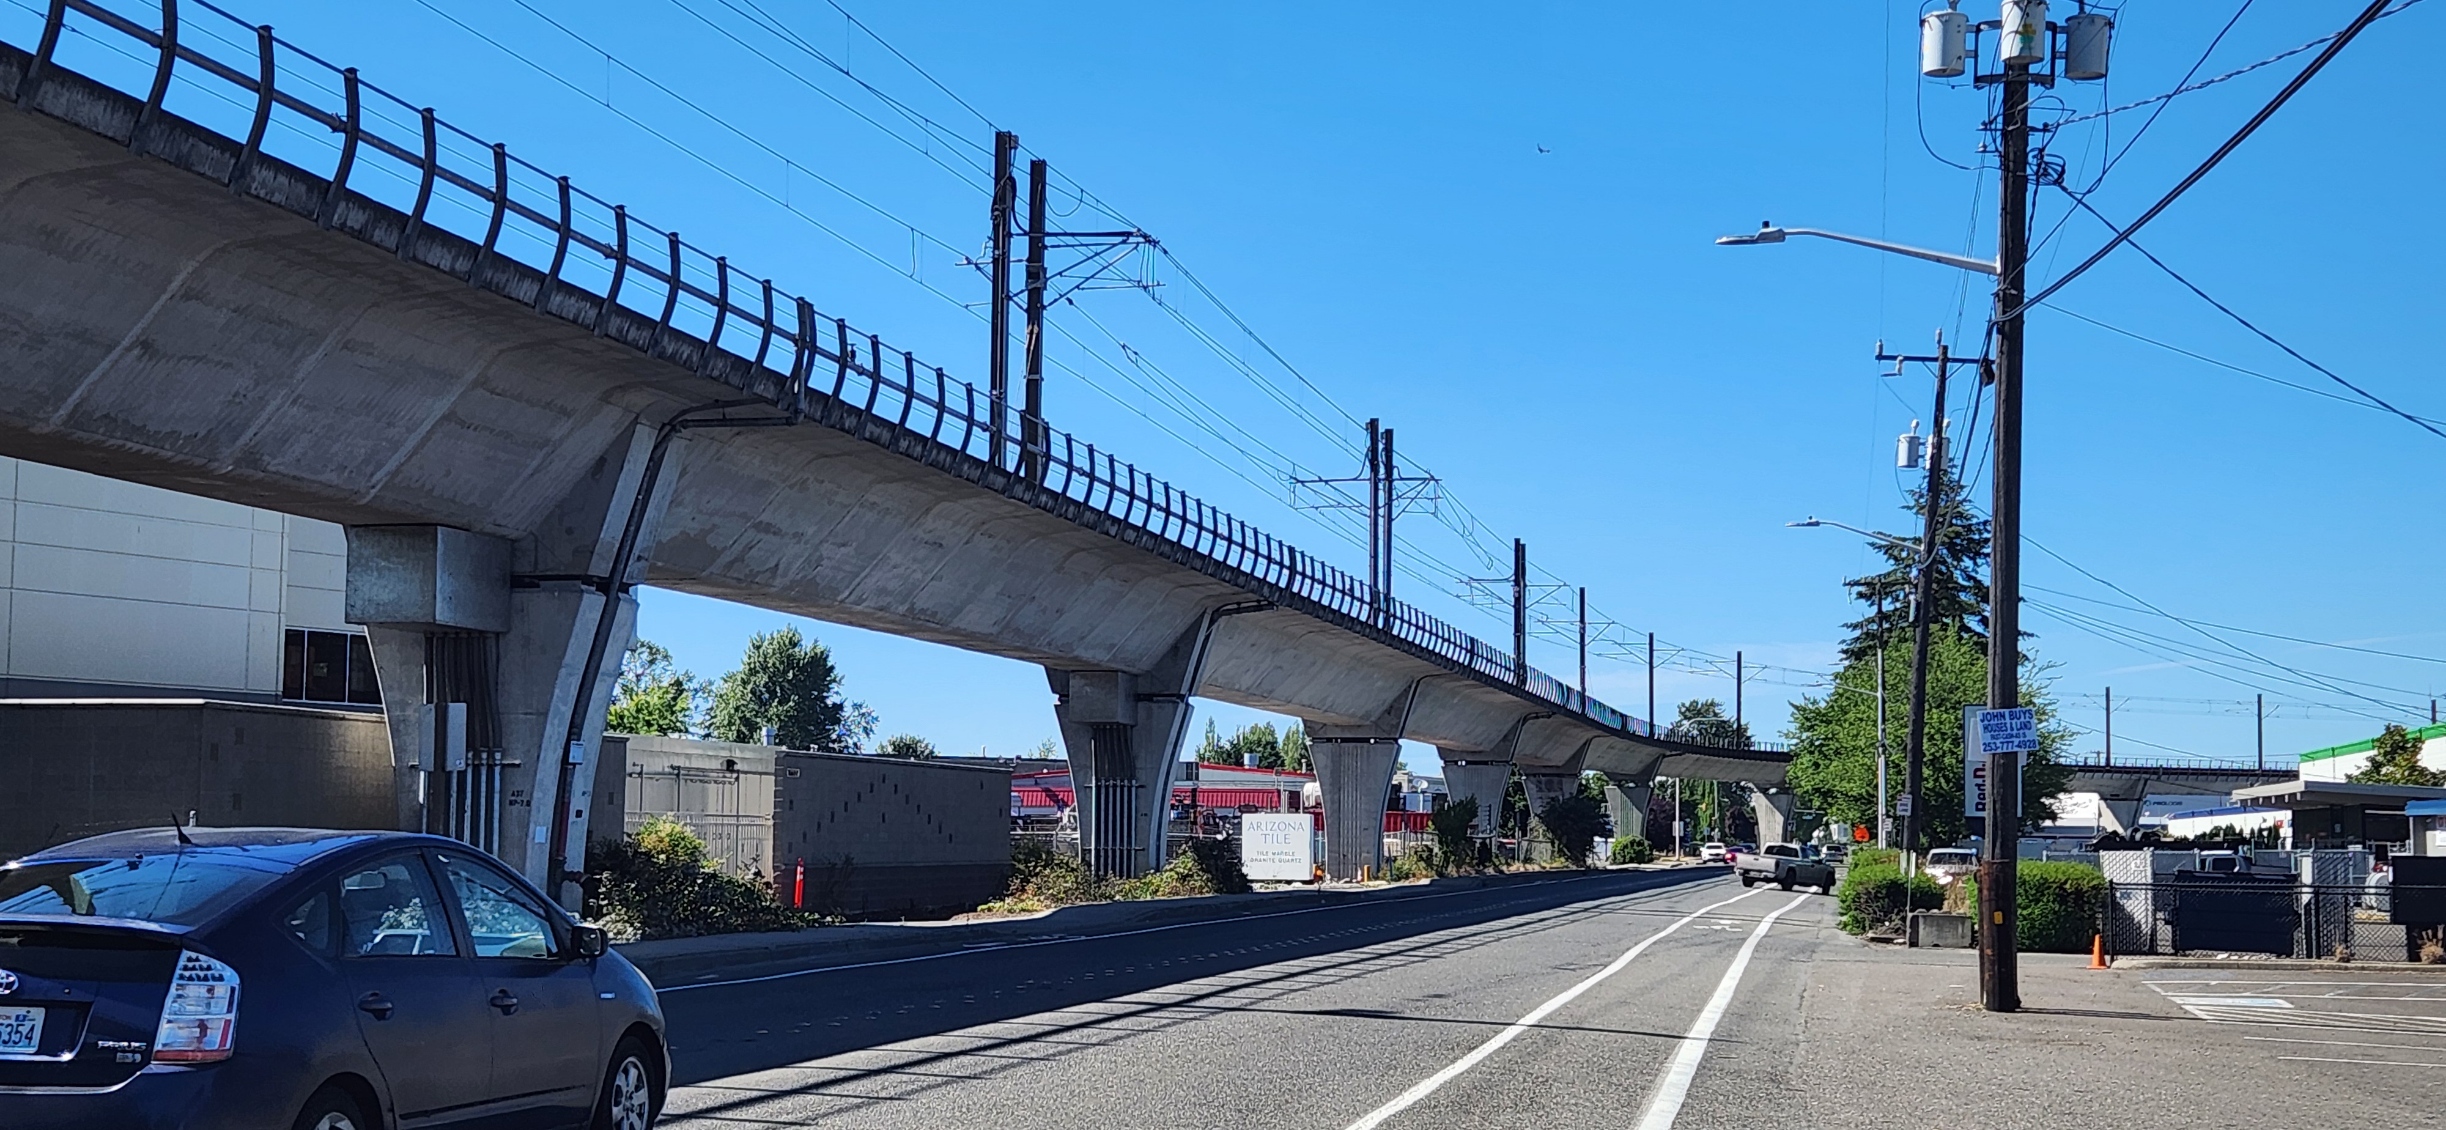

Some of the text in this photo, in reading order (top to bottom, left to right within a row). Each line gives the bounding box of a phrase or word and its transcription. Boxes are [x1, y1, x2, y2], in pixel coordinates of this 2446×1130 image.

[1980, 709, 2034, 723] JOHN BUYS
[1983, 722, 2008, 733] HOUSES
[2015, 721, 2032, 731] LAND
[1247, 821, 1305, 832] ARIZONA
[1261, 833, 1291, 844] TILE
